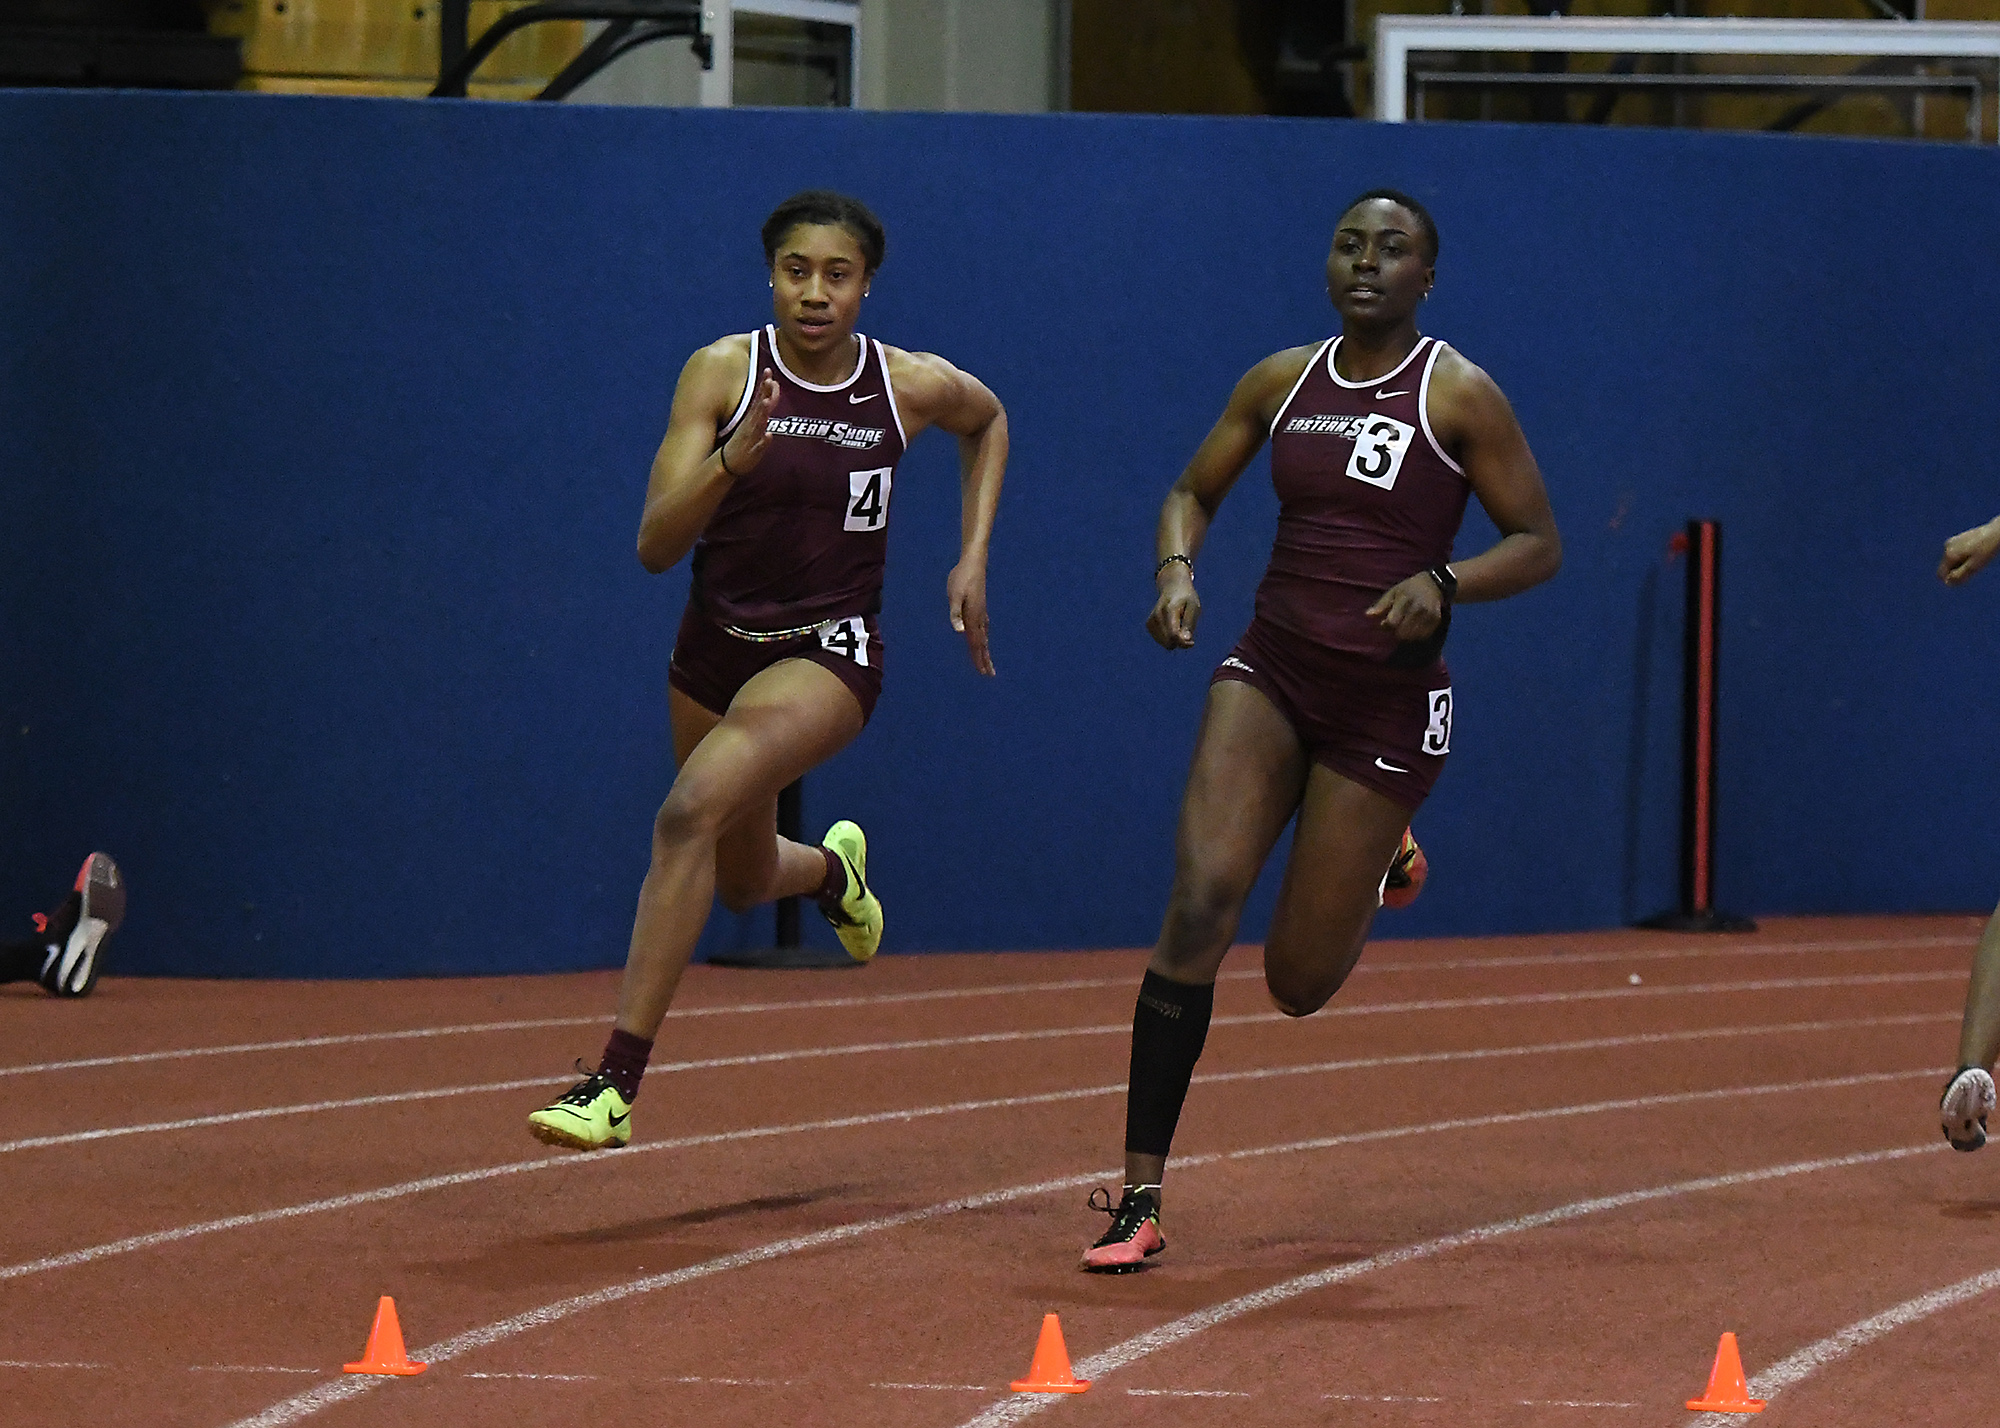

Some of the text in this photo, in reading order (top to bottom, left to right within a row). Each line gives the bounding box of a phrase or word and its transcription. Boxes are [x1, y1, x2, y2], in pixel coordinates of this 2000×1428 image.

[766, 419, 831, 436] ASTERN
[828, 423, 883, 442] SHORE
[1286, 419, 1350, 432] EASTERN
[1356, 421, 1401, 479] 3
[851, 473, 883, 527] 4
[827, 620, 860, 660] 4
[1429, 693, 1450, 751] 3
